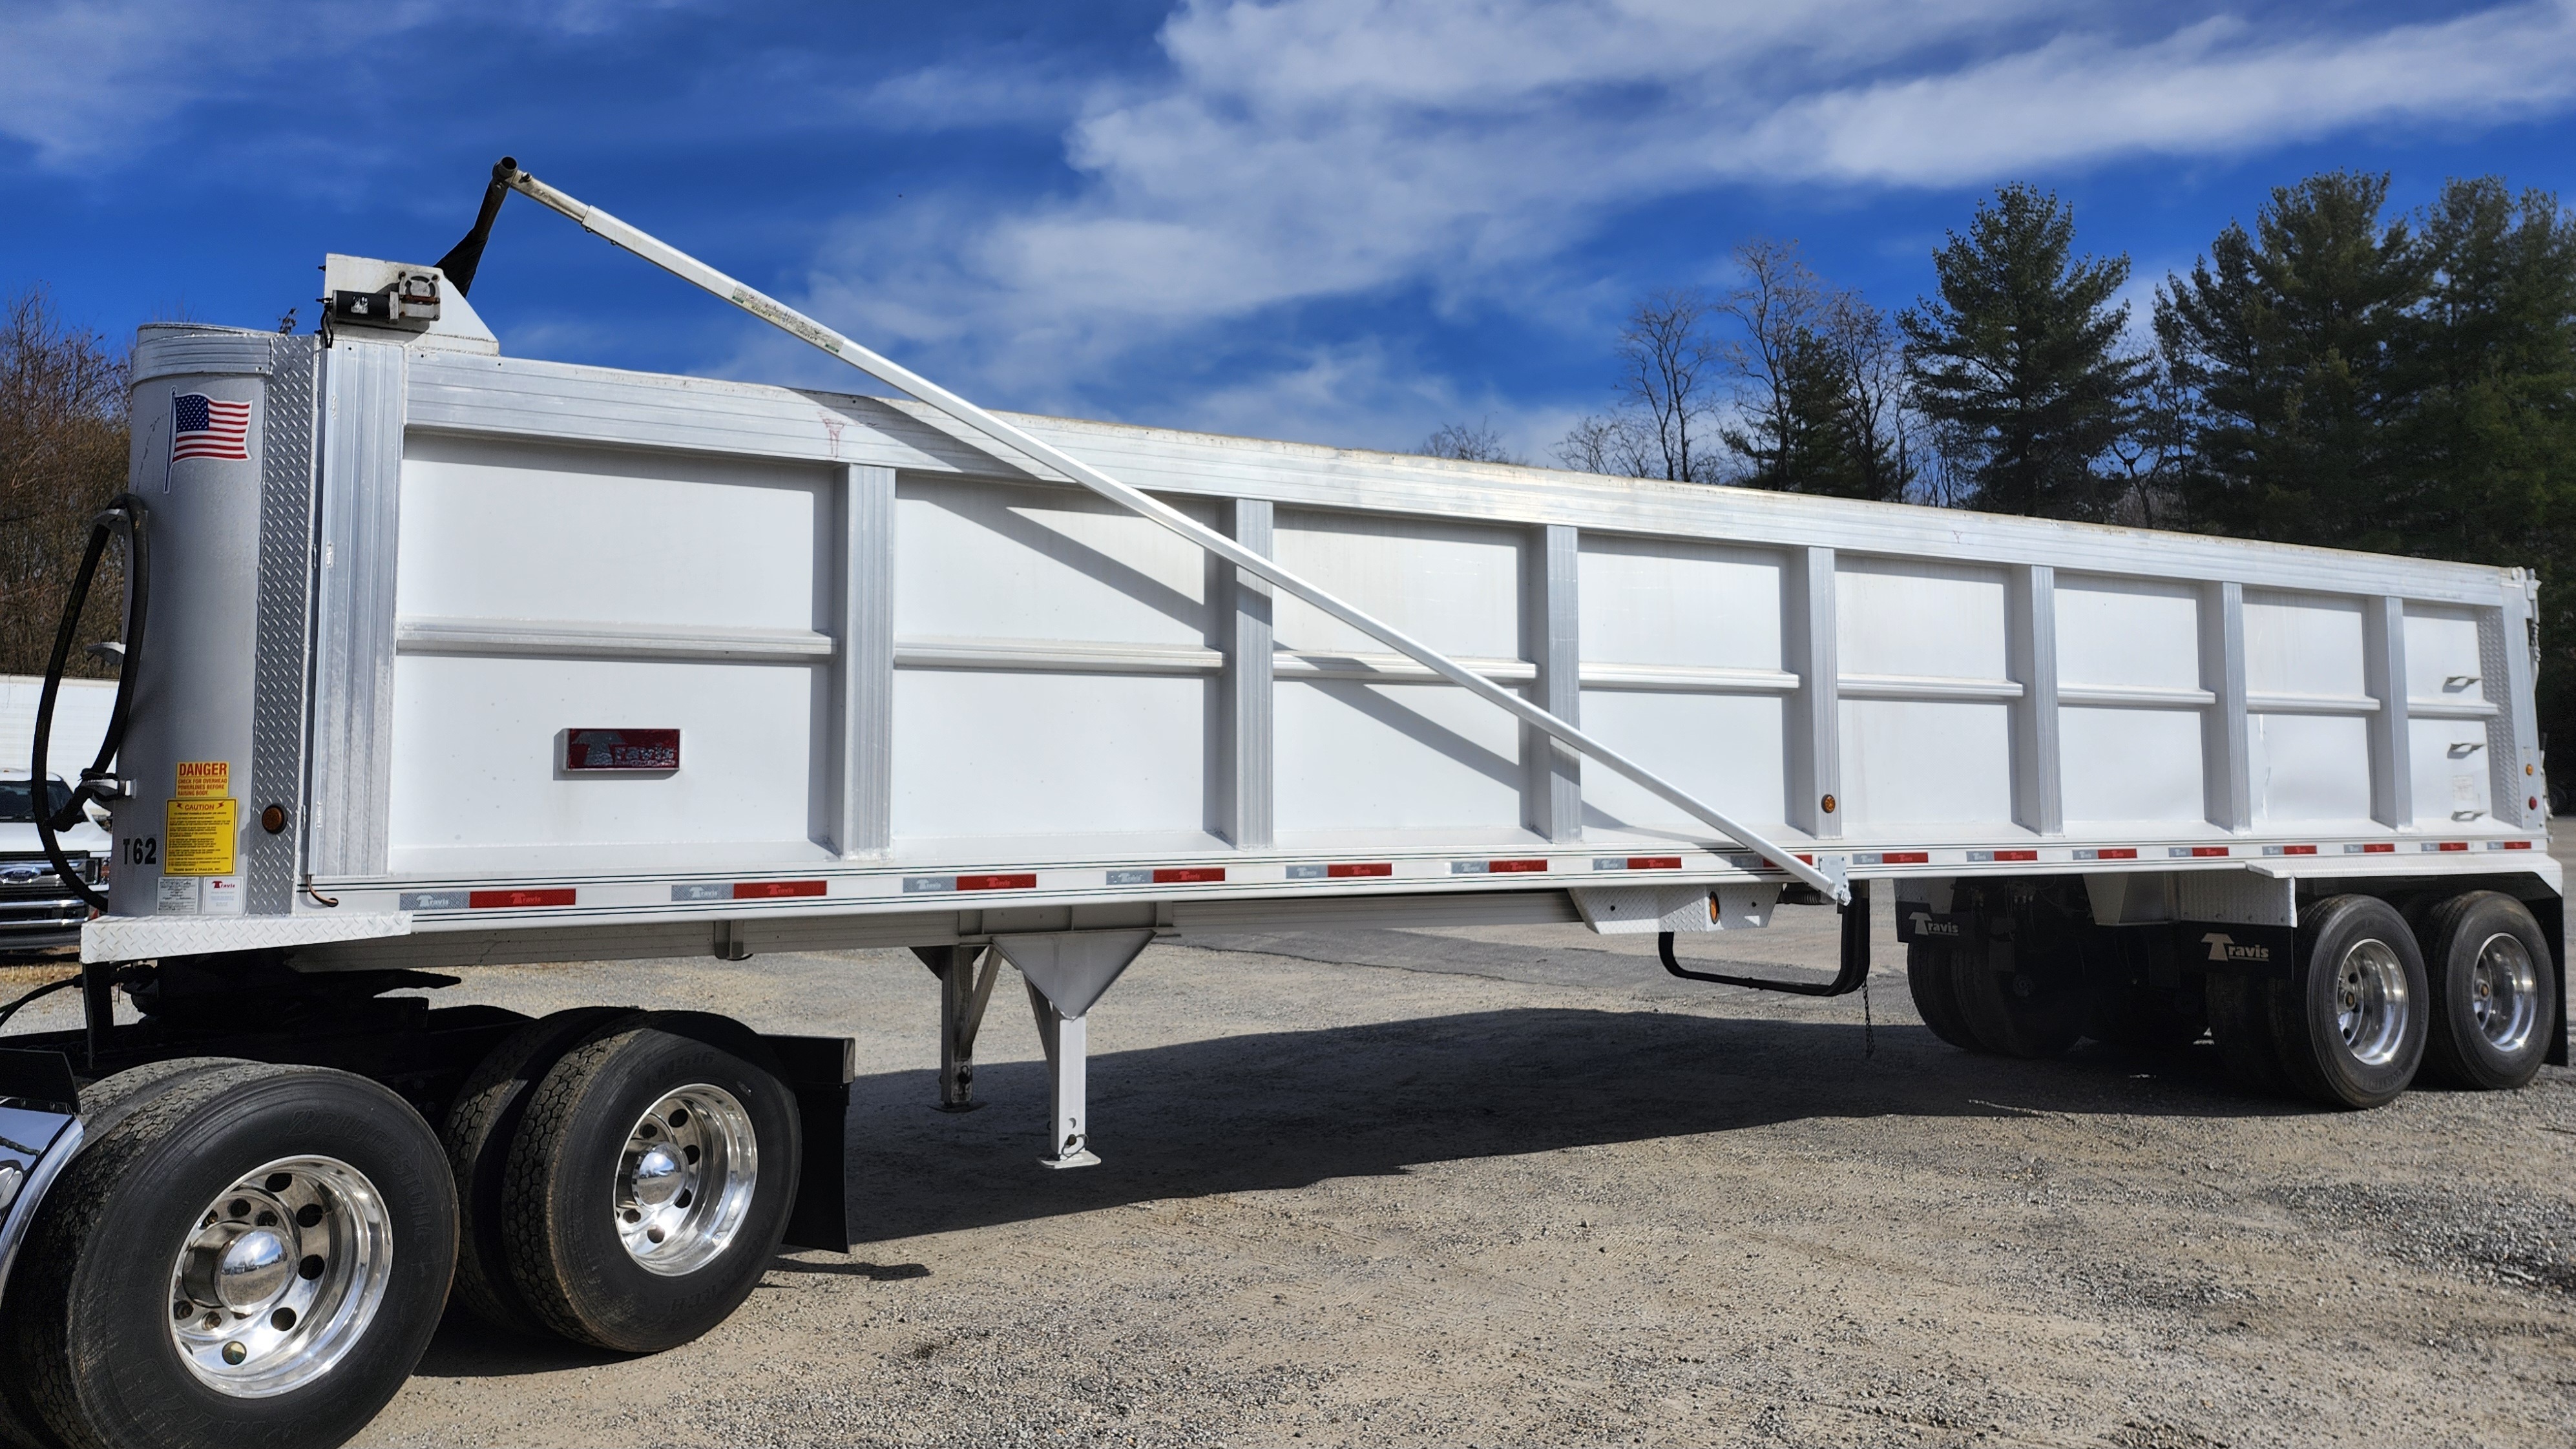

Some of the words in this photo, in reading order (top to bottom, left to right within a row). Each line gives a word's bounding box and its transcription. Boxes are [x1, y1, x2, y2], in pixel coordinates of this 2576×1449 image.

[179, 763, 227, 776] DANGER
[211, 881, 235, 889] Travis
[767, 884, 793, 895] Travis
[916, 879, 941, 890] Travis
[689, 886, 718, 898] Travis
[416, 894, 449, 907] Travis
[510, 893, 541, 904] Travis
[1909, 912, 1959, 935] Travis
[2201, 932, 2269, 962] Travis
[285, 1109, 433, 1244] BRIDGESTONE
